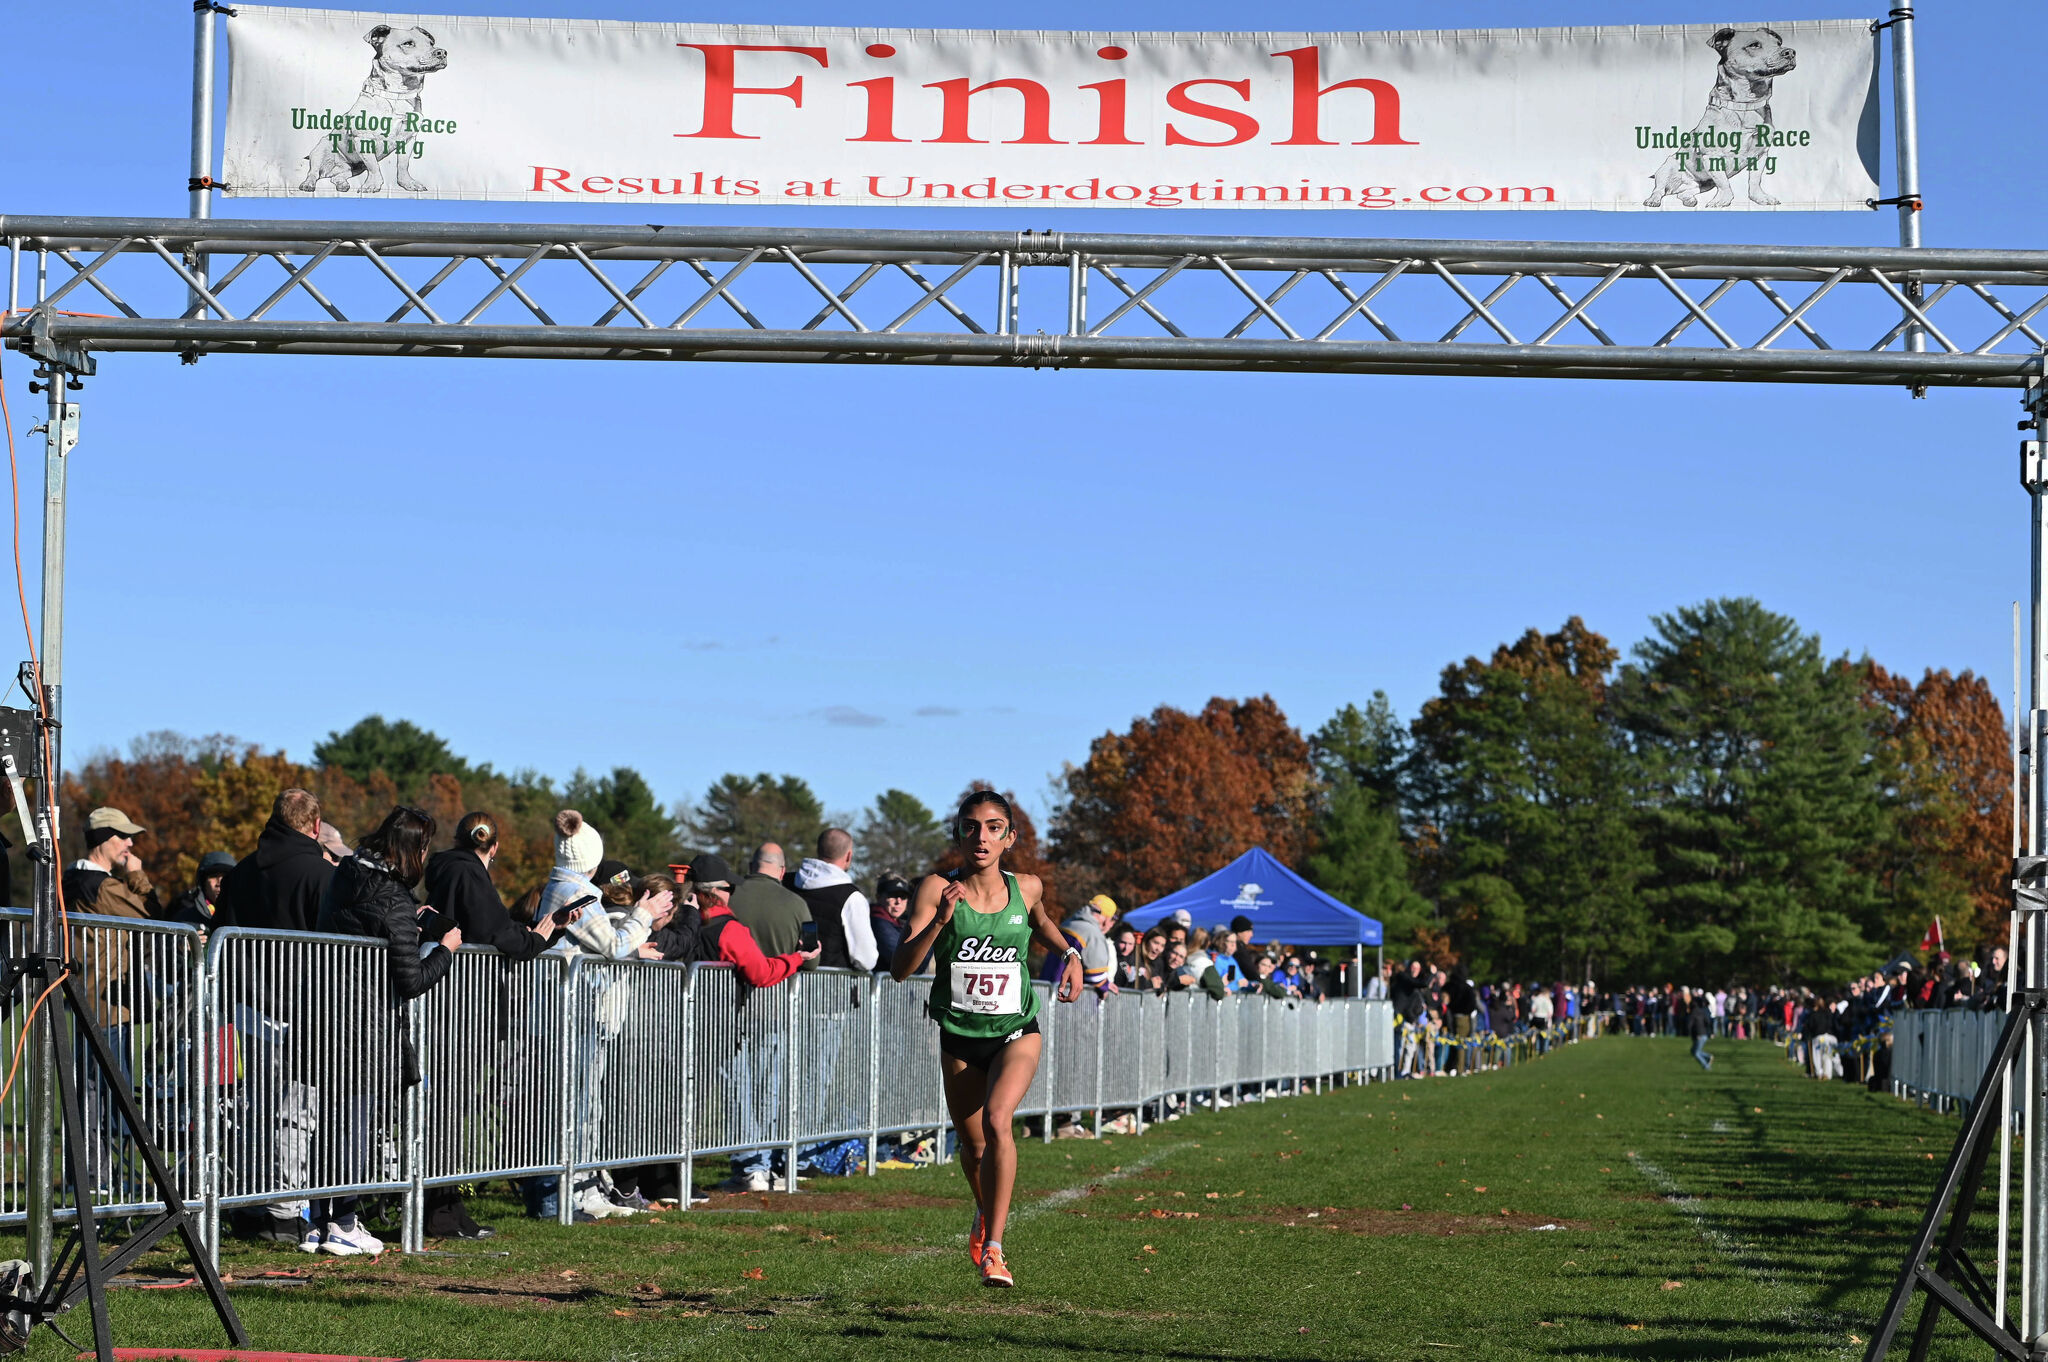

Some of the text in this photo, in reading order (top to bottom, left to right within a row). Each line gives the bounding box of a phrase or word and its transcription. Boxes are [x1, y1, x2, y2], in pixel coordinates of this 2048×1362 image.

[674, 44, 1420, 147] Finish
[291, 108, 457, 137] Underdog Race
[329, 133, 425, 159] Timing
[1635, 124, 1811, 155] Underdog Race
[1676, 152, 1777, 174] Timing
[532, 166, 1556, 209] Results at Underdogtiming.com
[956, 935, 1018, 962] Shen
[964, 973, 1010, 996] 757
